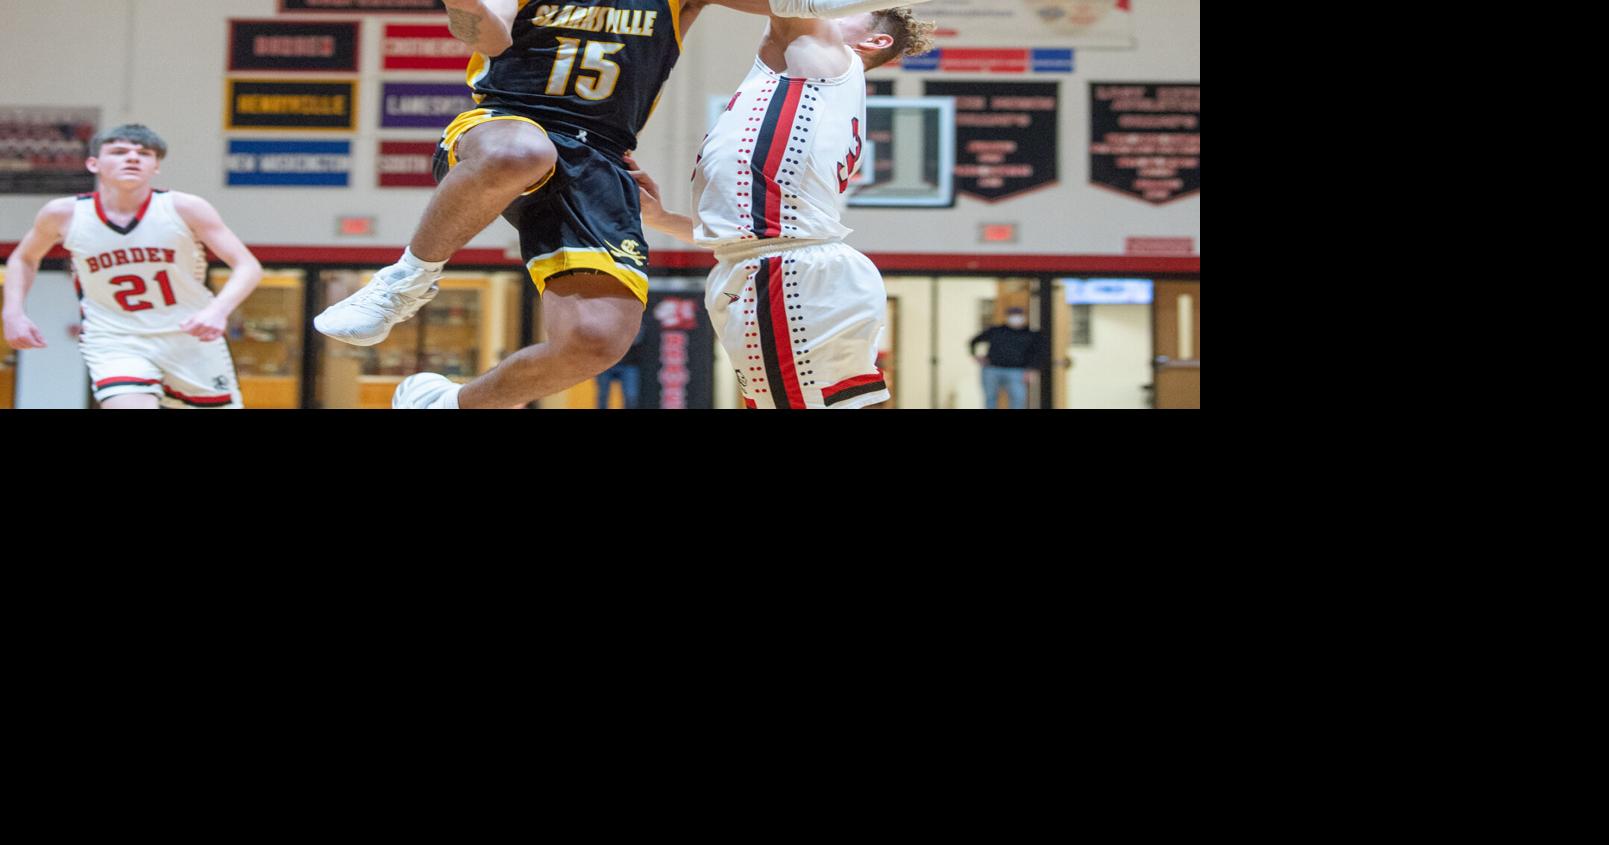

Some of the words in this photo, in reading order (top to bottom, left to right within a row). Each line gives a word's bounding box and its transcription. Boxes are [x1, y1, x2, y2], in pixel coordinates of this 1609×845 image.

[544, 36, 626, 100] 15
[86, 246, 177, 273] BORDEN
[109, 269, 178, 313] 21
